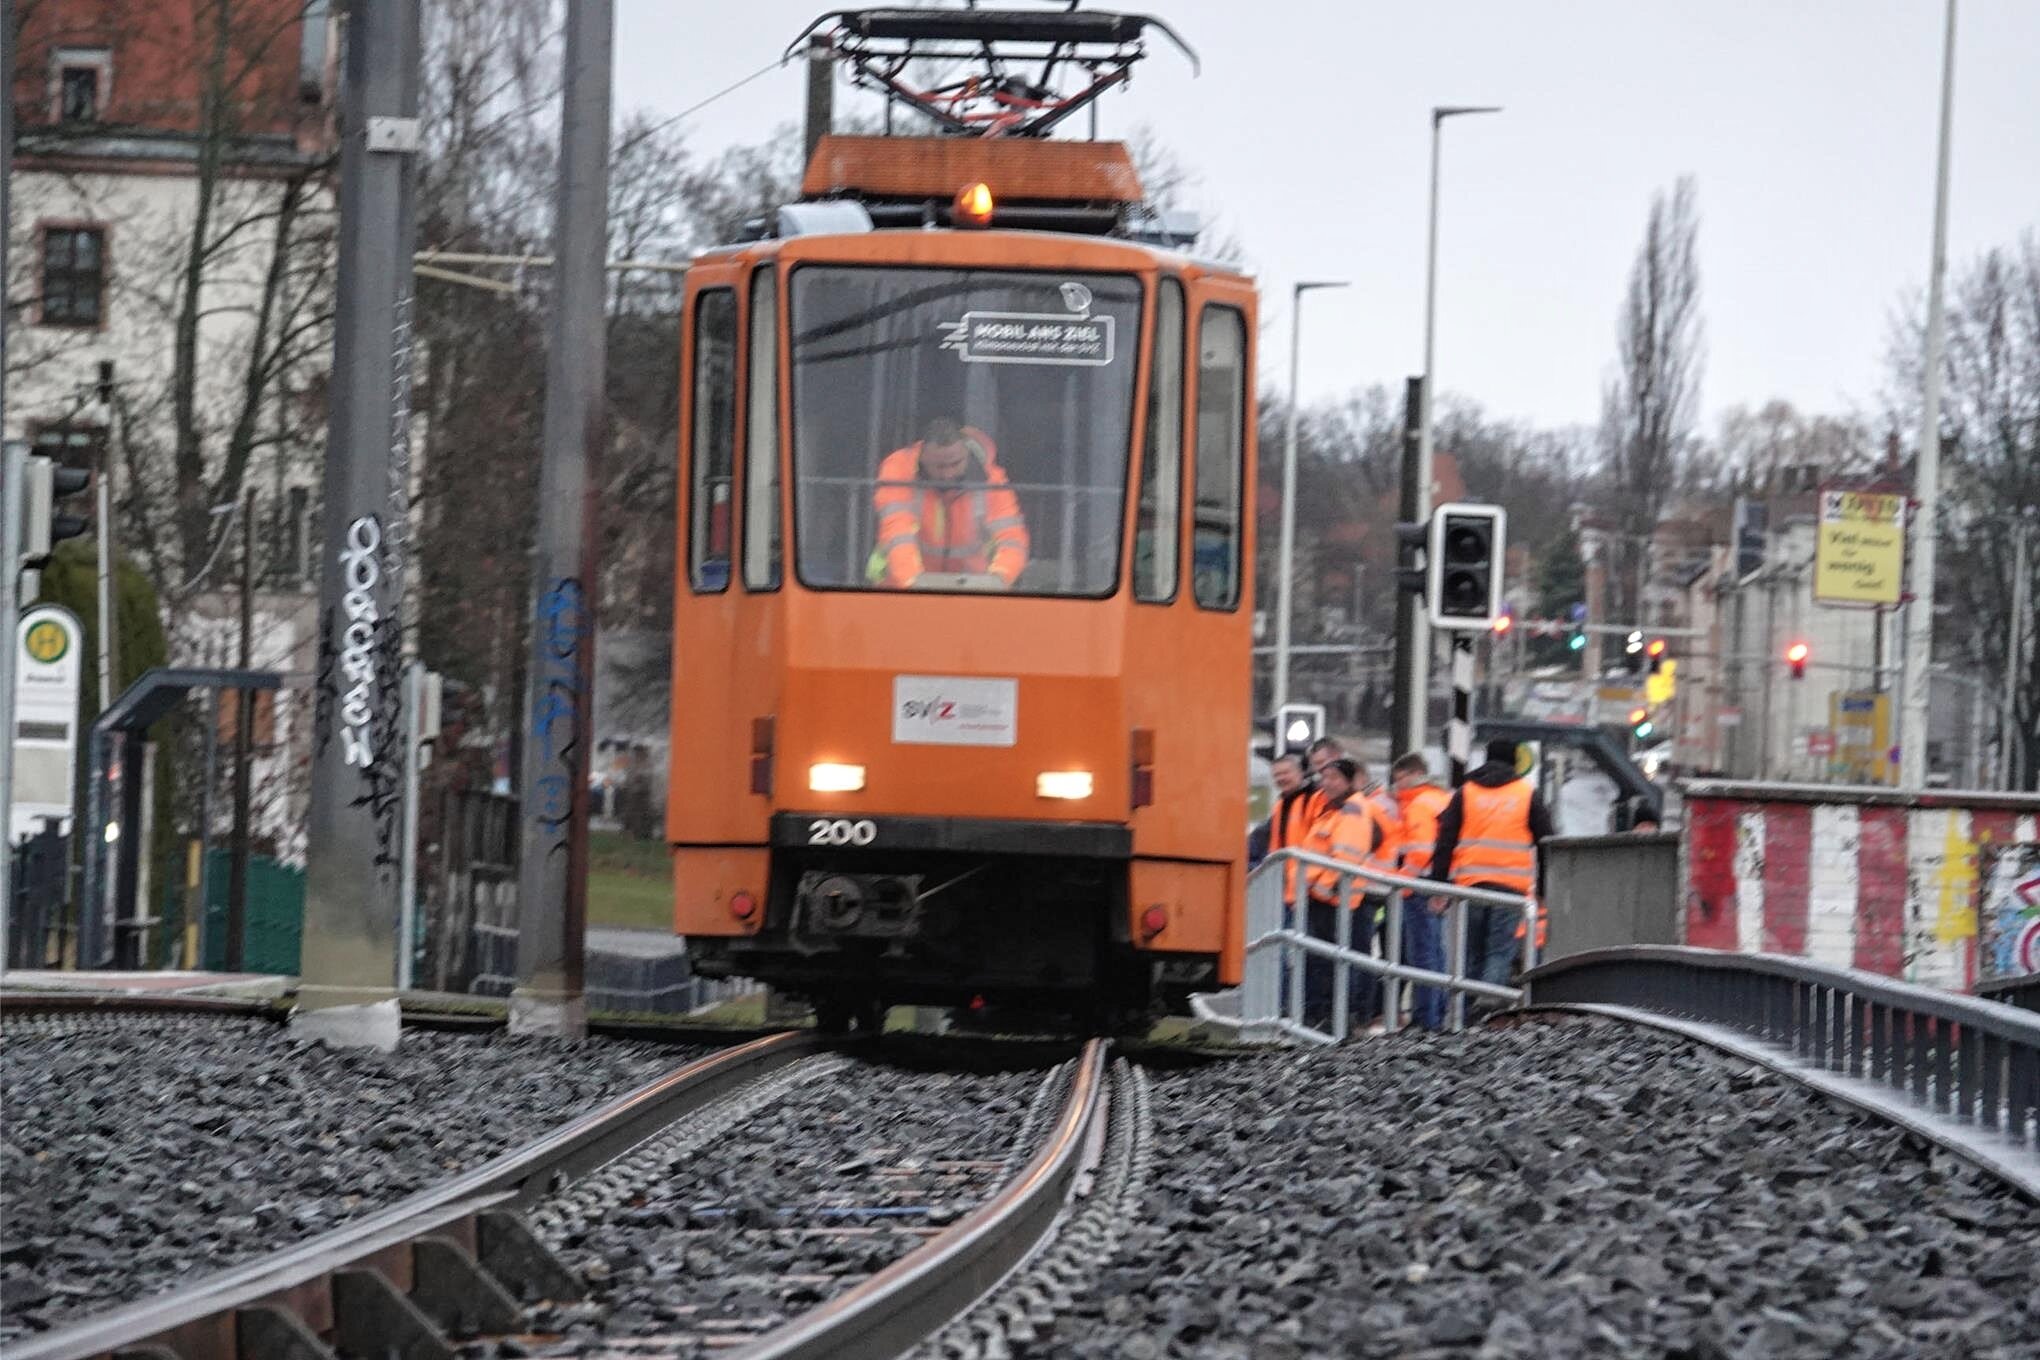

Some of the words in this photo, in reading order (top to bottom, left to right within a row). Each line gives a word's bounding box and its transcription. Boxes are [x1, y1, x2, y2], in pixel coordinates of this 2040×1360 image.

[974, 323, 1027, 338] MOBIL
[1027, 325, 1063, 340] ANS
[1062, 326, 1101, 341] ZIEL
[808, 819, 878, 846] 200
